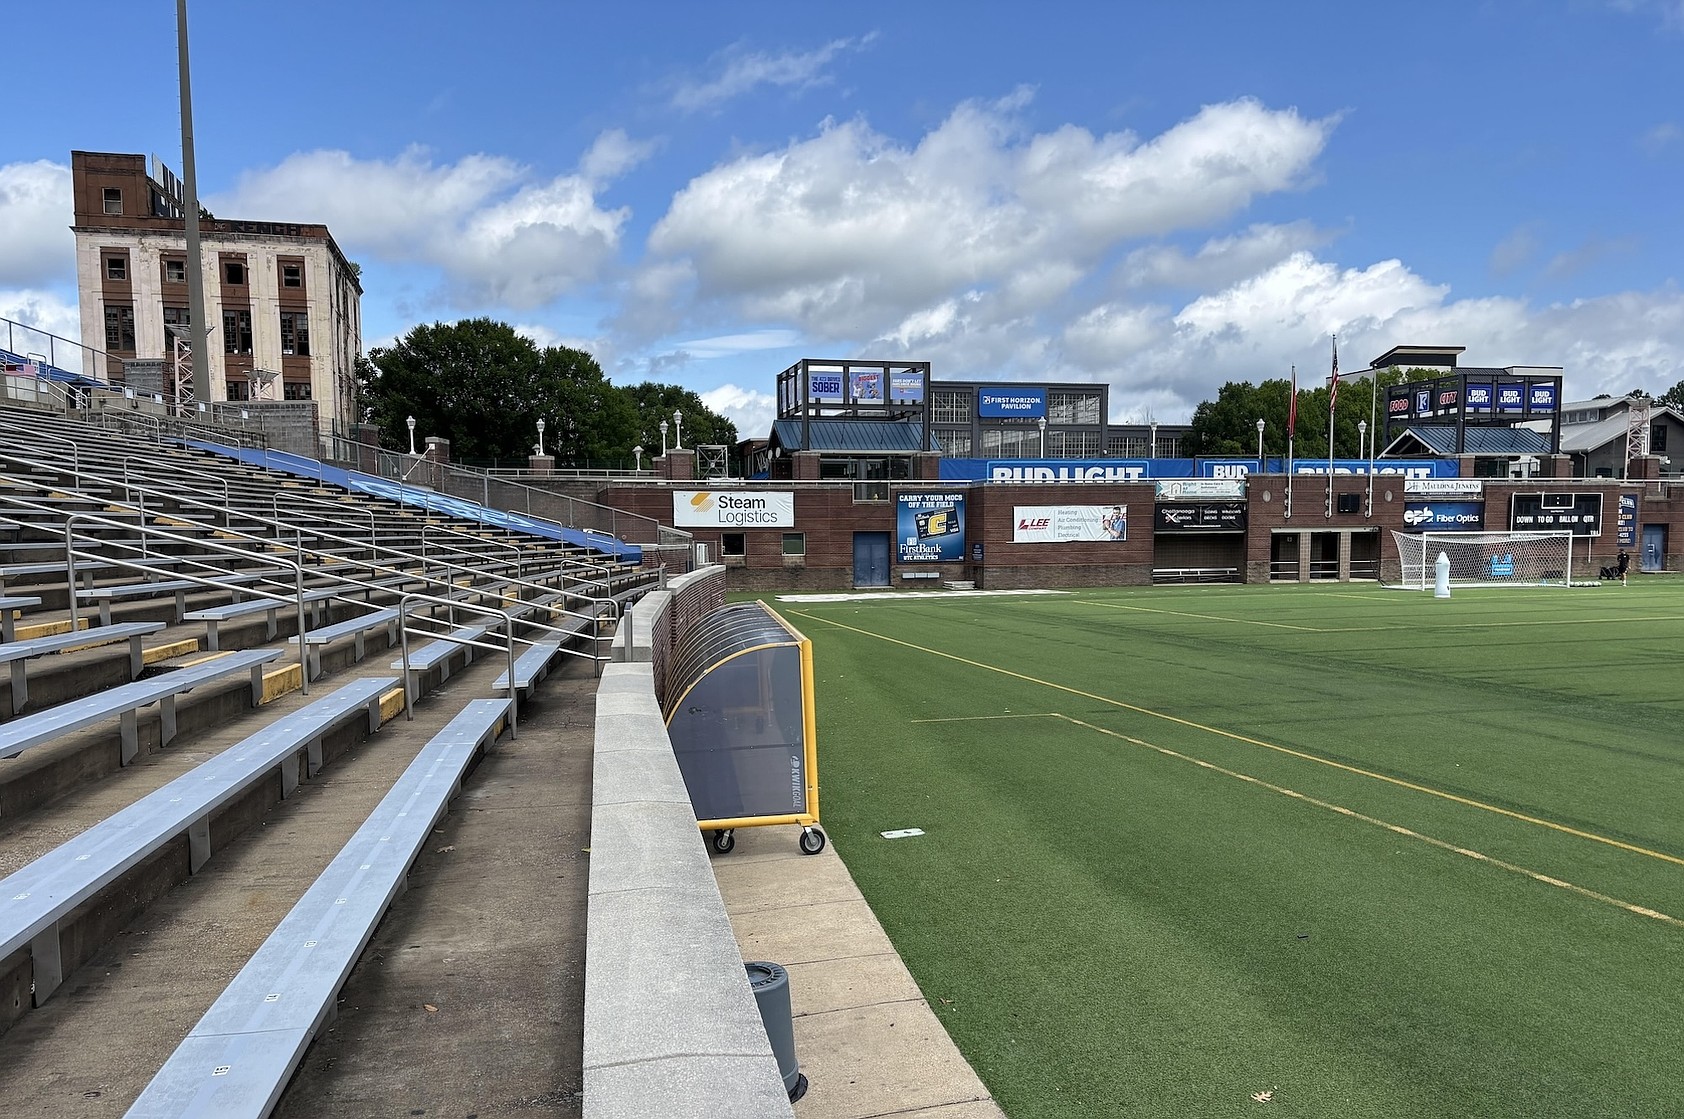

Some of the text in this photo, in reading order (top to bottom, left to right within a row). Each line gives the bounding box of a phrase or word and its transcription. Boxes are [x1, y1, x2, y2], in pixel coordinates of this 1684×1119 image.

[812, 382, 840, 393] SOBER
[1471, 389, 1487, 397] BUD
[1440, 391, 1457, 405] CITY
[1500, 396, 1521, 404] LIGHT
[1390, 399, 1409, 412] FOOD
[1213, 465, 1249, 478] BUD
[718, 495, 766, 509] Steam
[718, 510, 778, 526] Logistics
[1030, 518, 1051, 527] LEE
[1456, 514, 1479, 524] Optics
[1516, 515, 1595, 524] DOWN TO GO BALL ON QTR
